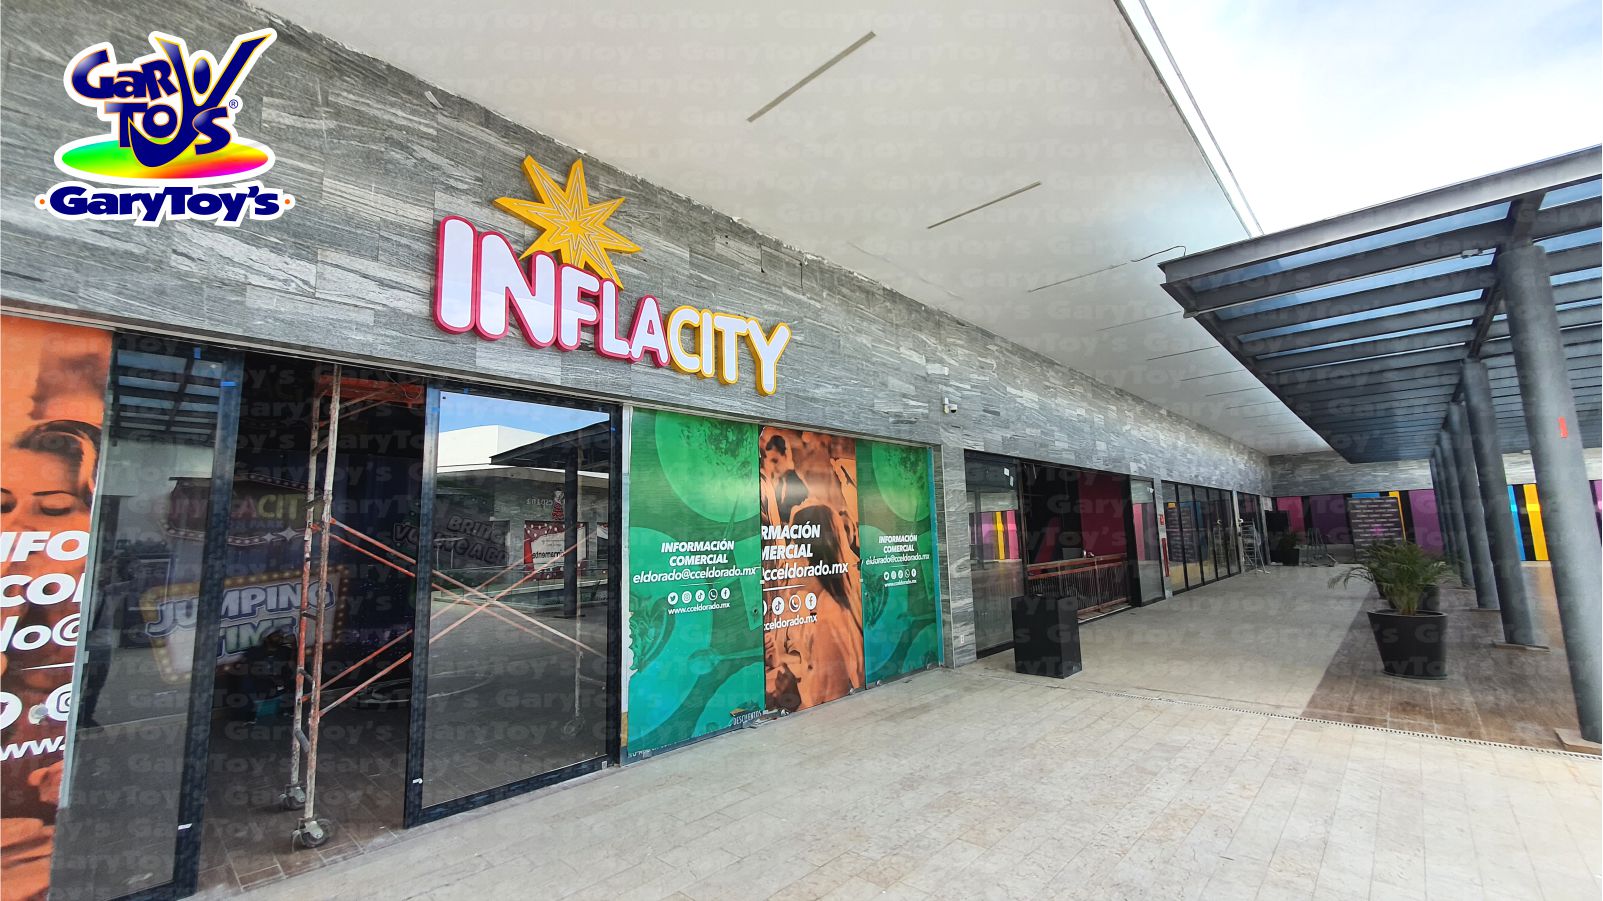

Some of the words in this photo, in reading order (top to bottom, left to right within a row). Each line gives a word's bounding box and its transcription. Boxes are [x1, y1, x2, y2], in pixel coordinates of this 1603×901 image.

[433, 215, 792, 396] INFLACITY
[878, 533, 918, 543] INFORMACIÓN
[661, 539, 735, 553] INFORMACIÓN
[883, 544, 915, 553] COMERCIAL
[669, 553, 729, 567] COMERCIAL
[633, 565, 757, 584] eldorado@cceldorado.mx
[668, 602, 731, 615] www.cceldorado.mx
